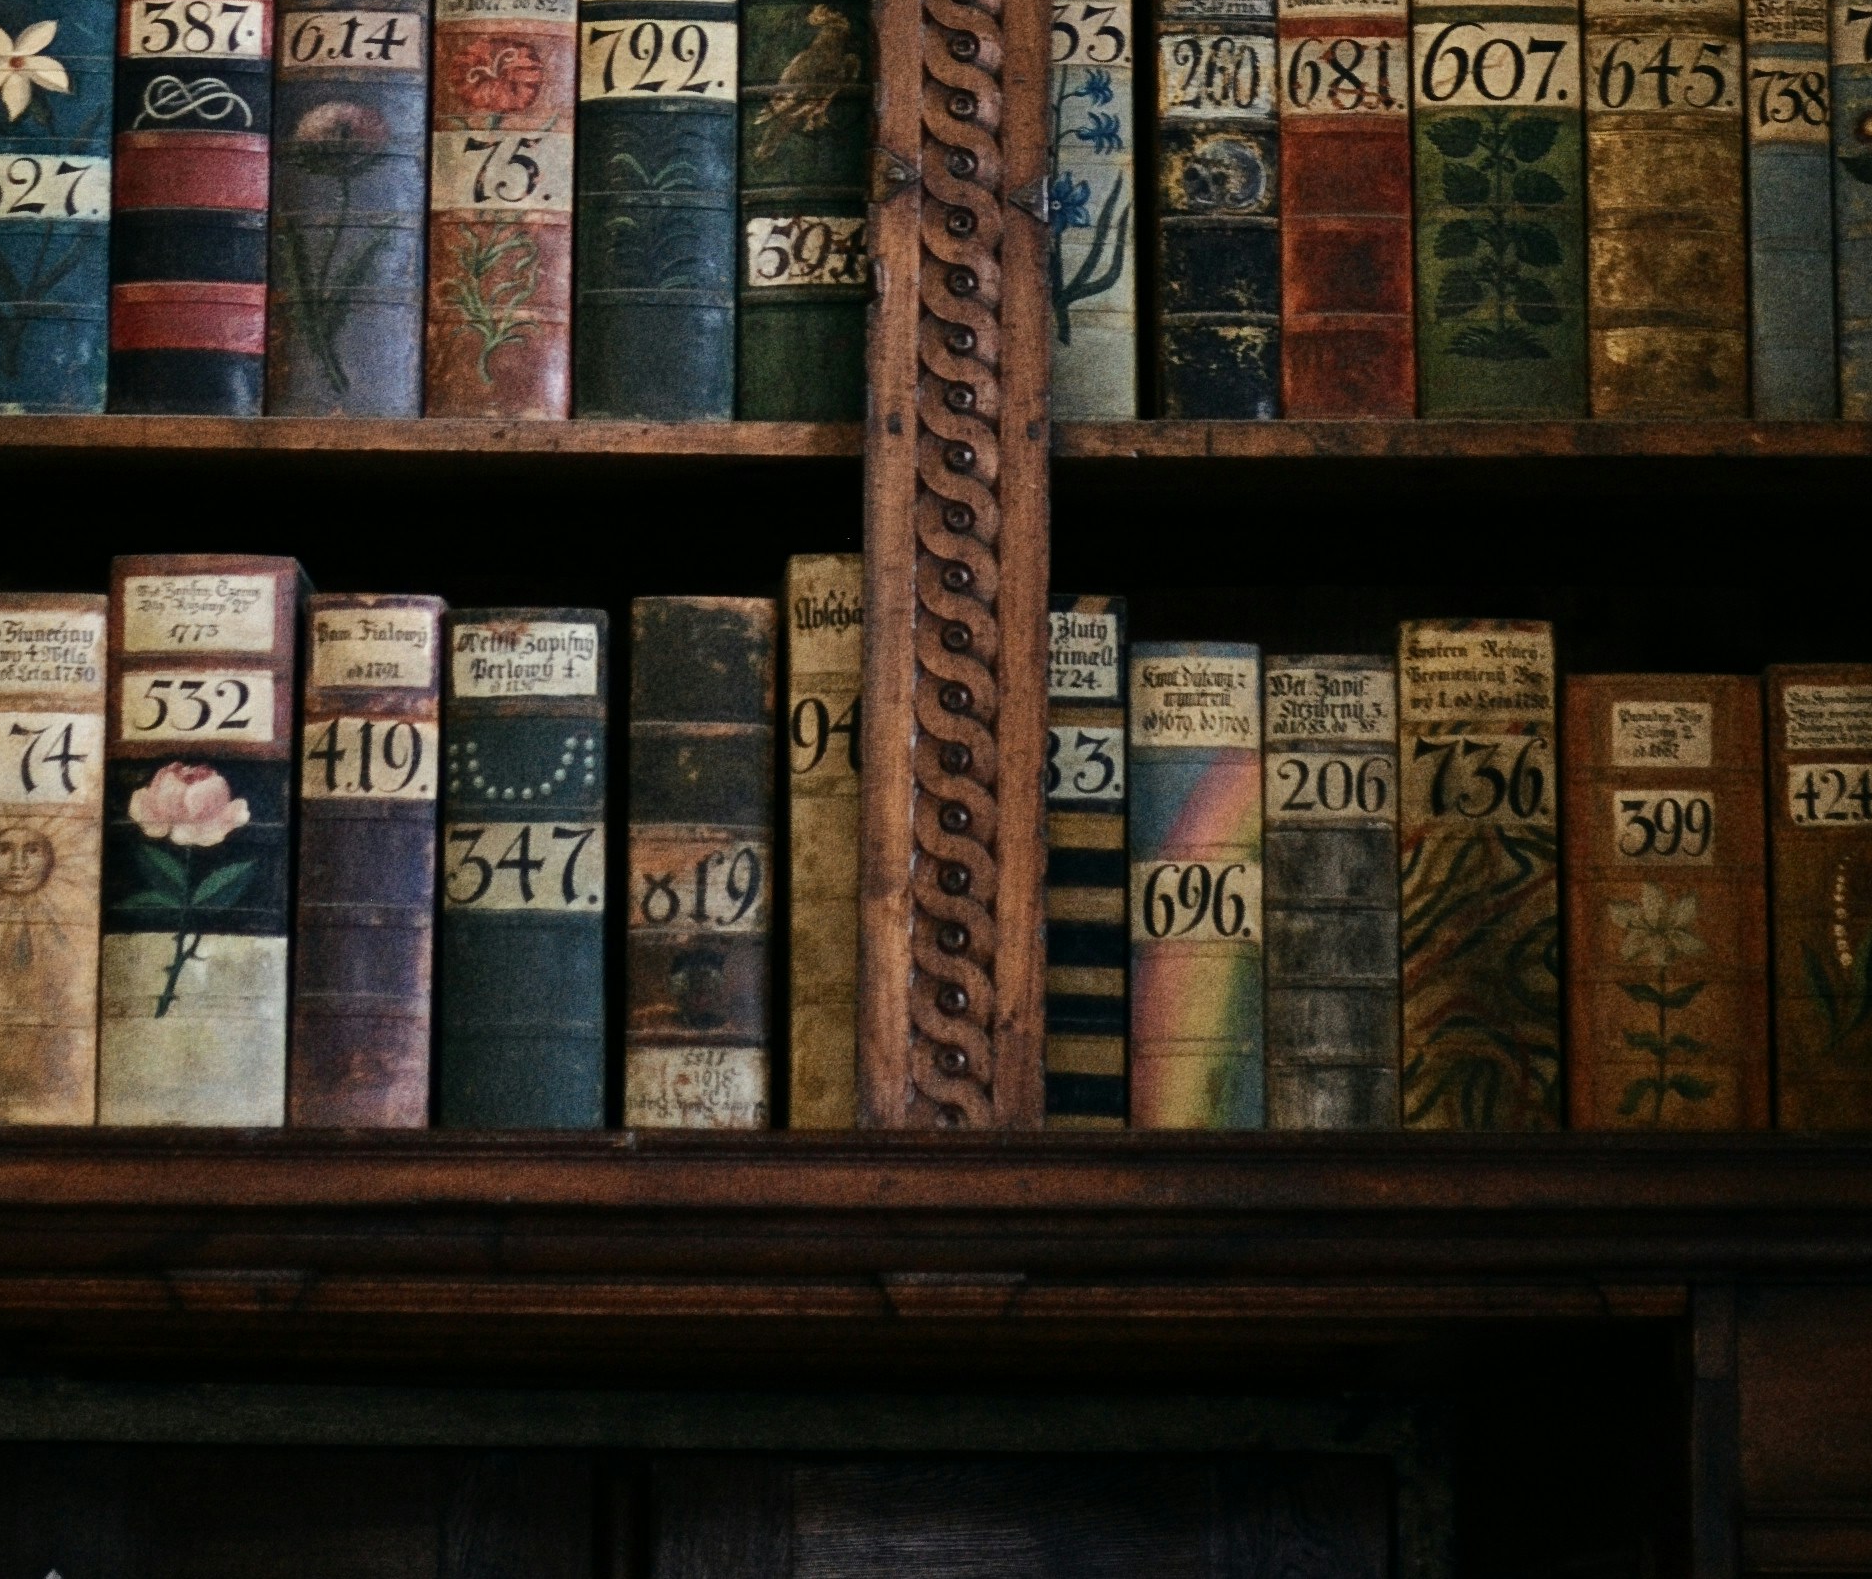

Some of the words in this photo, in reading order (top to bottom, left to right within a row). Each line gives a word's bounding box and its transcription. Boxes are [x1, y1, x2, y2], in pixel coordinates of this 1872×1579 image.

[141, 1, 256, 53] 387.
[1421, 21, 1568, 103] 607.
[1288, 37, 1405, 112] 681.
[1597, 36, 1735, 110] 645.
[1752, 66, 1827, 126] 738
[463, 136, 552, 204] 75.
[135, 679, 253, 731] 532
[306, 719, 428, 793] 419.
[1277, 756, 1393, 813] 206
[1413, 737, 1550, 820] 736.
[1618, 797, 1713, 858] 399
[445, 825, 599, 906] 347.
[1141, 862, 1251, 939] 696.
